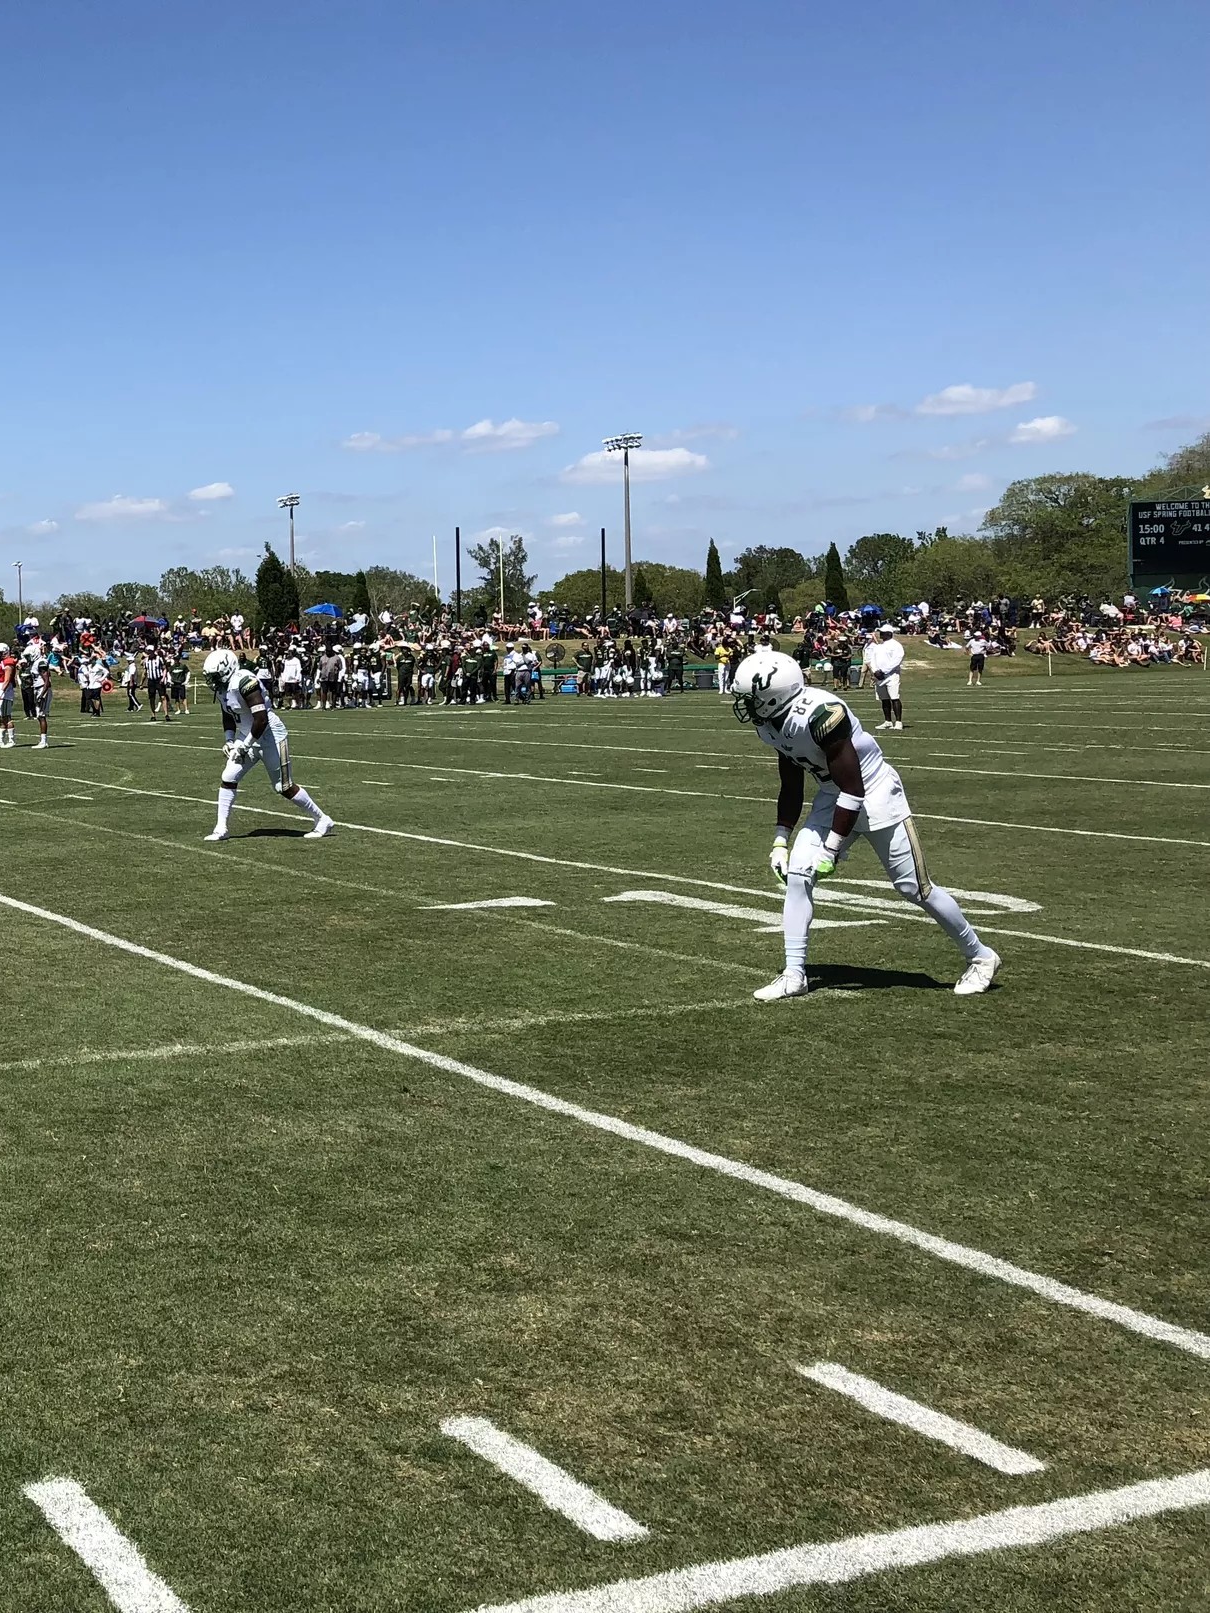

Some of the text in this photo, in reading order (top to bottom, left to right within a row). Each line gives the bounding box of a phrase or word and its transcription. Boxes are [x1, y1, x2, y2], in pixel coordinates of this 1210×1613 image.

[1138, 511, 1151, 519] USF
[1138, 524, 1165, 534] 15:00
[1139, 536, 1165, 546] QTR 4
